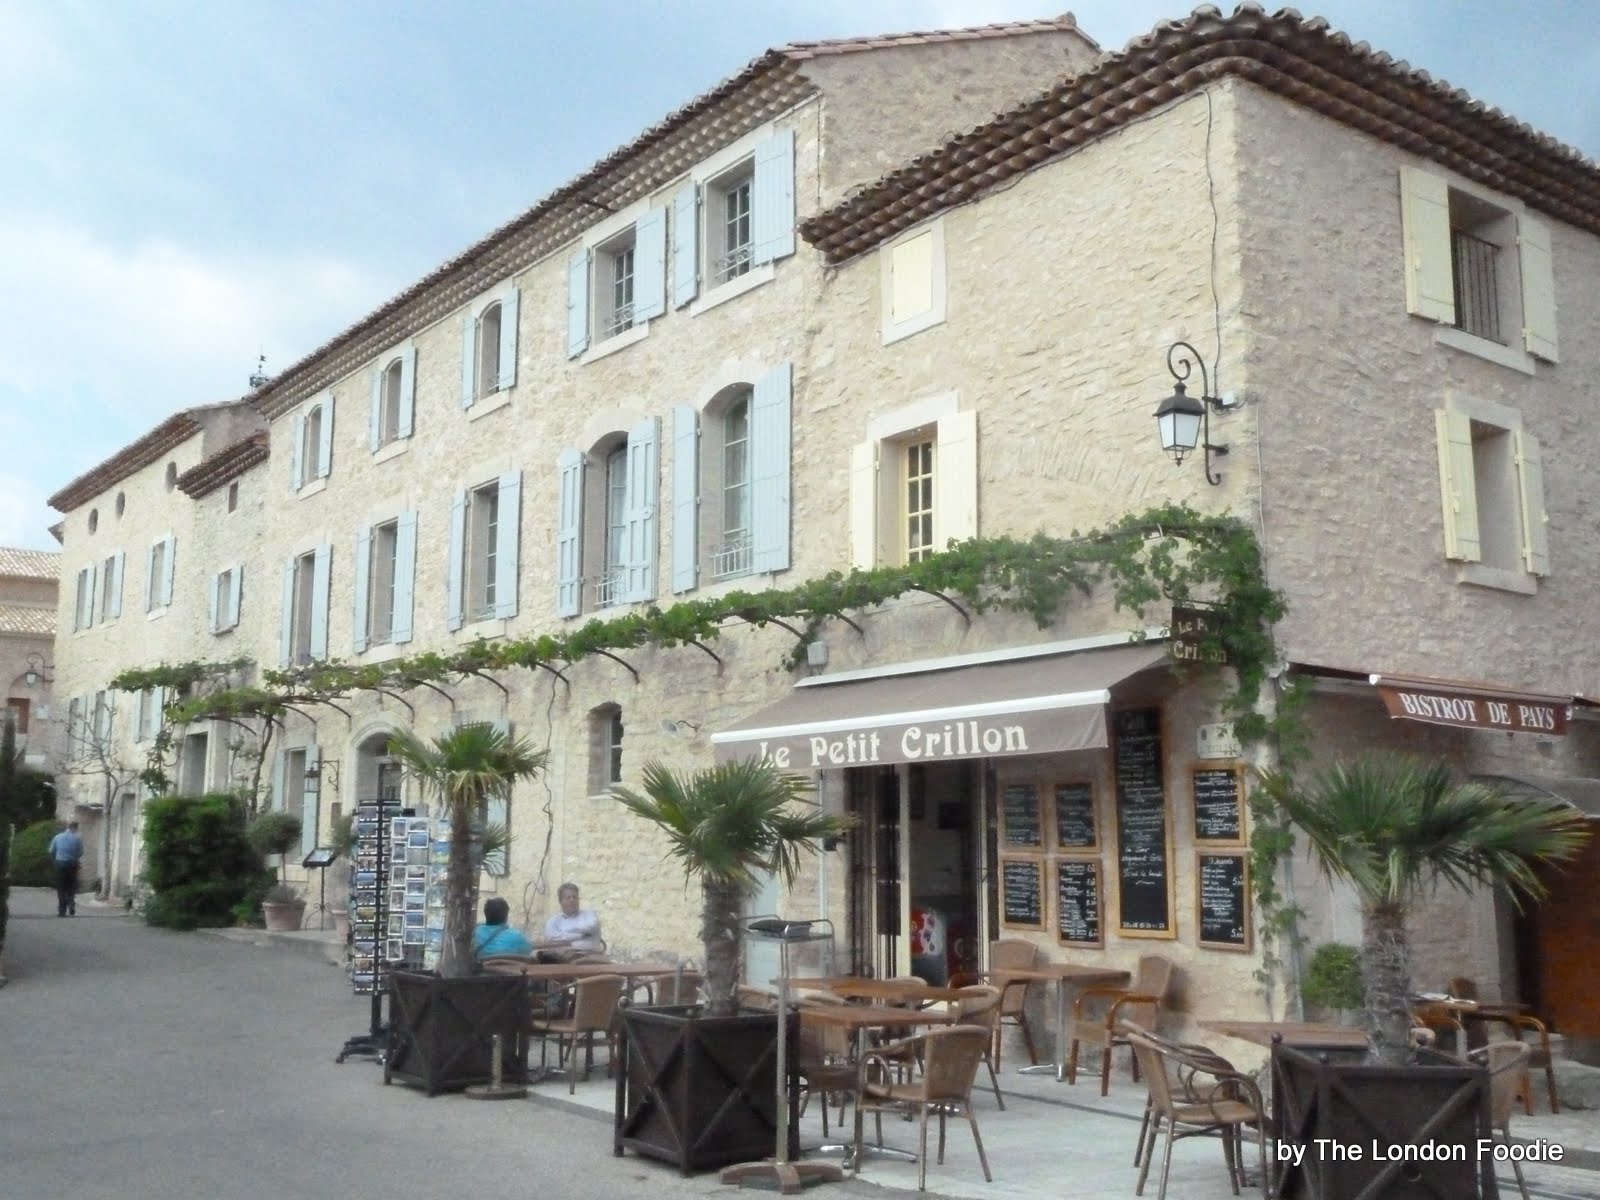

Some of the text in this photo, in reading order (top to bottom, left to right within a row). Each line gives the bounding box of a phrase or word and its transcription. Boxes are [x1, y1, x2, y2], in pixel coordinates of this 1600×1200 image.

[1178, 621, 1193, 635] Le
[1398, 693, 1555, 730] BISTROT DE PAYS
[758, 720, 1029, 769] Le Petit Crillon
